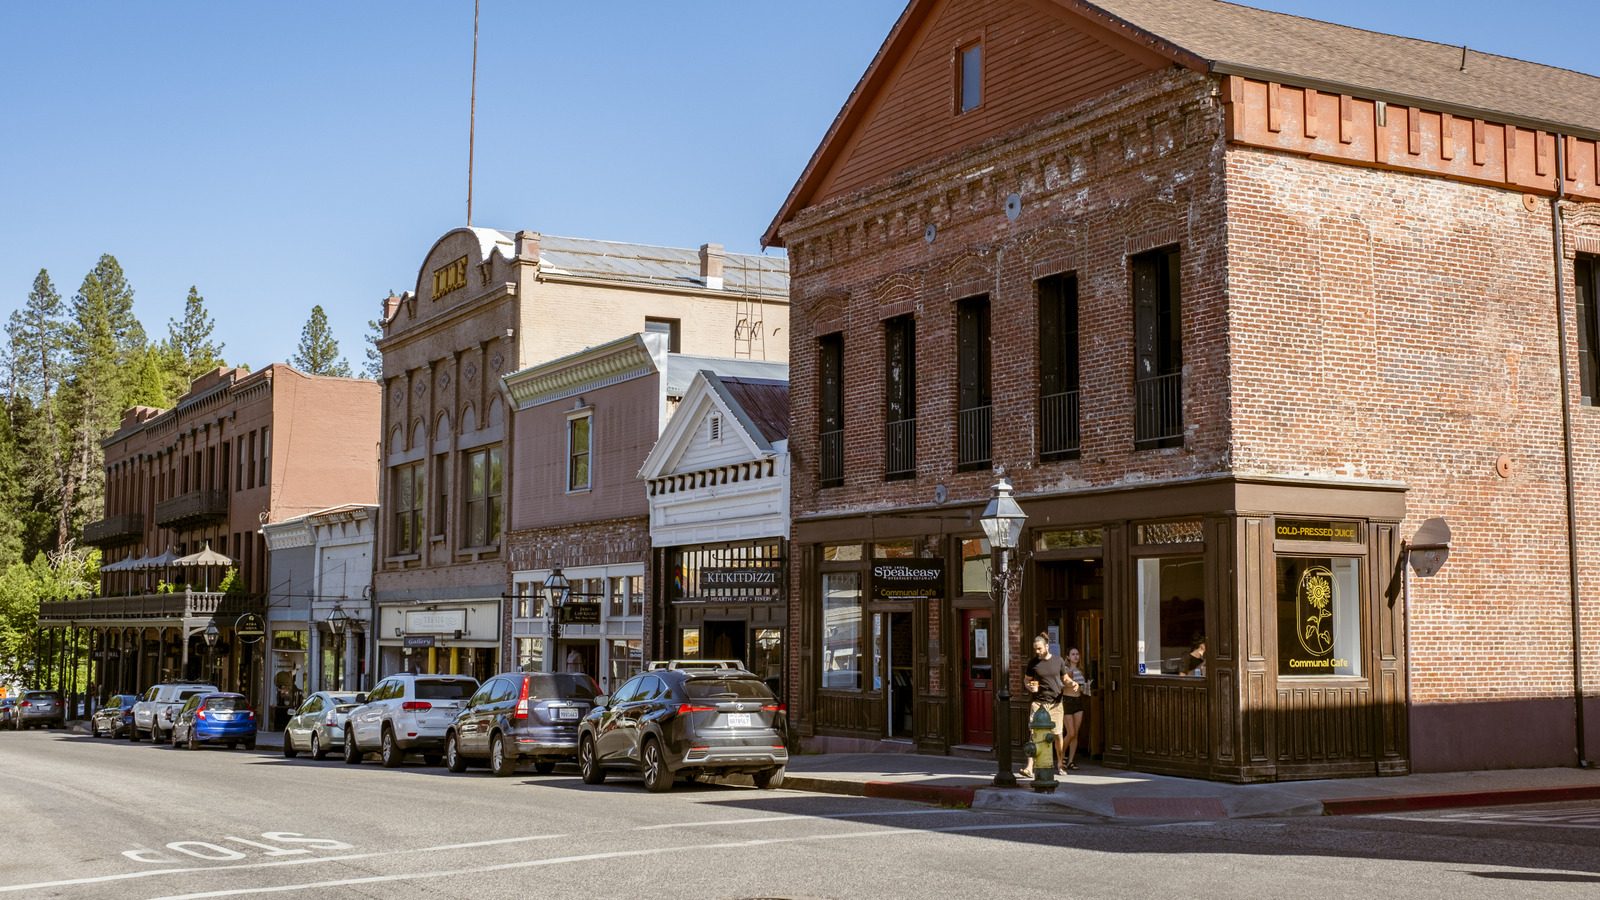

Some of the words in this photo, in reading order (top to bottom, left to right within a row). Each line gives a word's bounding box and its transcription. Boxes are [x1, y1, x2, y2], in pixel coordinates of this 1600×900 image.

[1277, 526, 1333, 537] COLD-PRESSED
[1335, 528, 1355, 538] JUICE
[707, 572, 775, 583] KITKITDIZZI
[874, 566, 941, 580] Speakeasy
[880, 588, 919, 597] Communal
[920, 588, 937, 596] Cafe
[1289, 658, 1329, 668] Communal
[1330, 658, 1348, 667] Cafe
